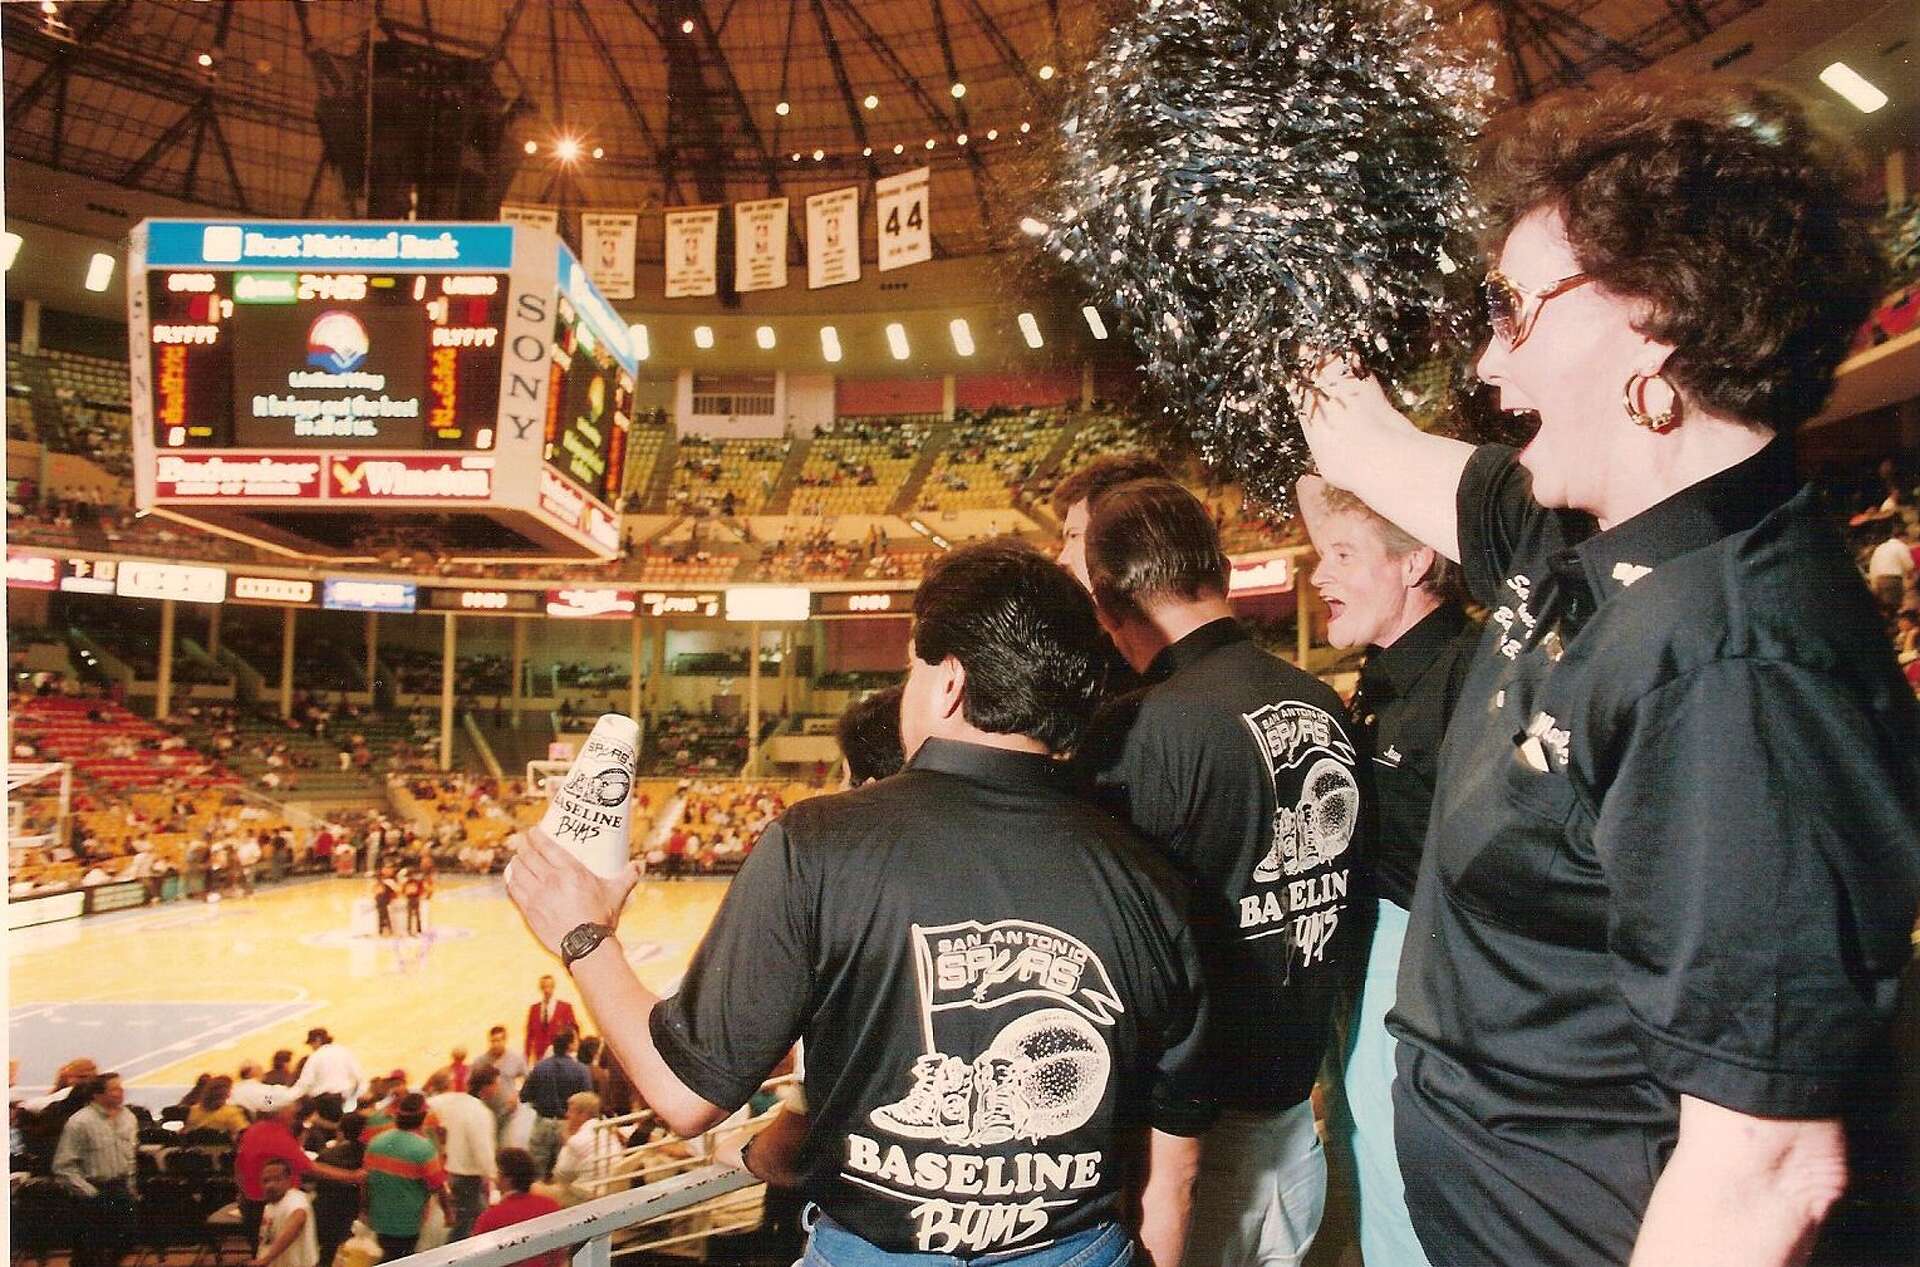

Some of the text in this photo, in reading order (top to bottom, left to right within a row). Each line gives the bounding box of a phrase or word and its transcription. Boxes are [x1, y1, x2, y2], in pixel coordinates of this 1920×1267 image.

[885, 201, 923, 237] 44
[508, 294, 546, 440] SONY
[937, 943, 1087, 1000] SPURS
[938, 930, 1088, 964] SAN ANTONIO
[849, 1133, 1102, 1196] BASELINE
[910, 1197, 1049, 1253] BUMS
